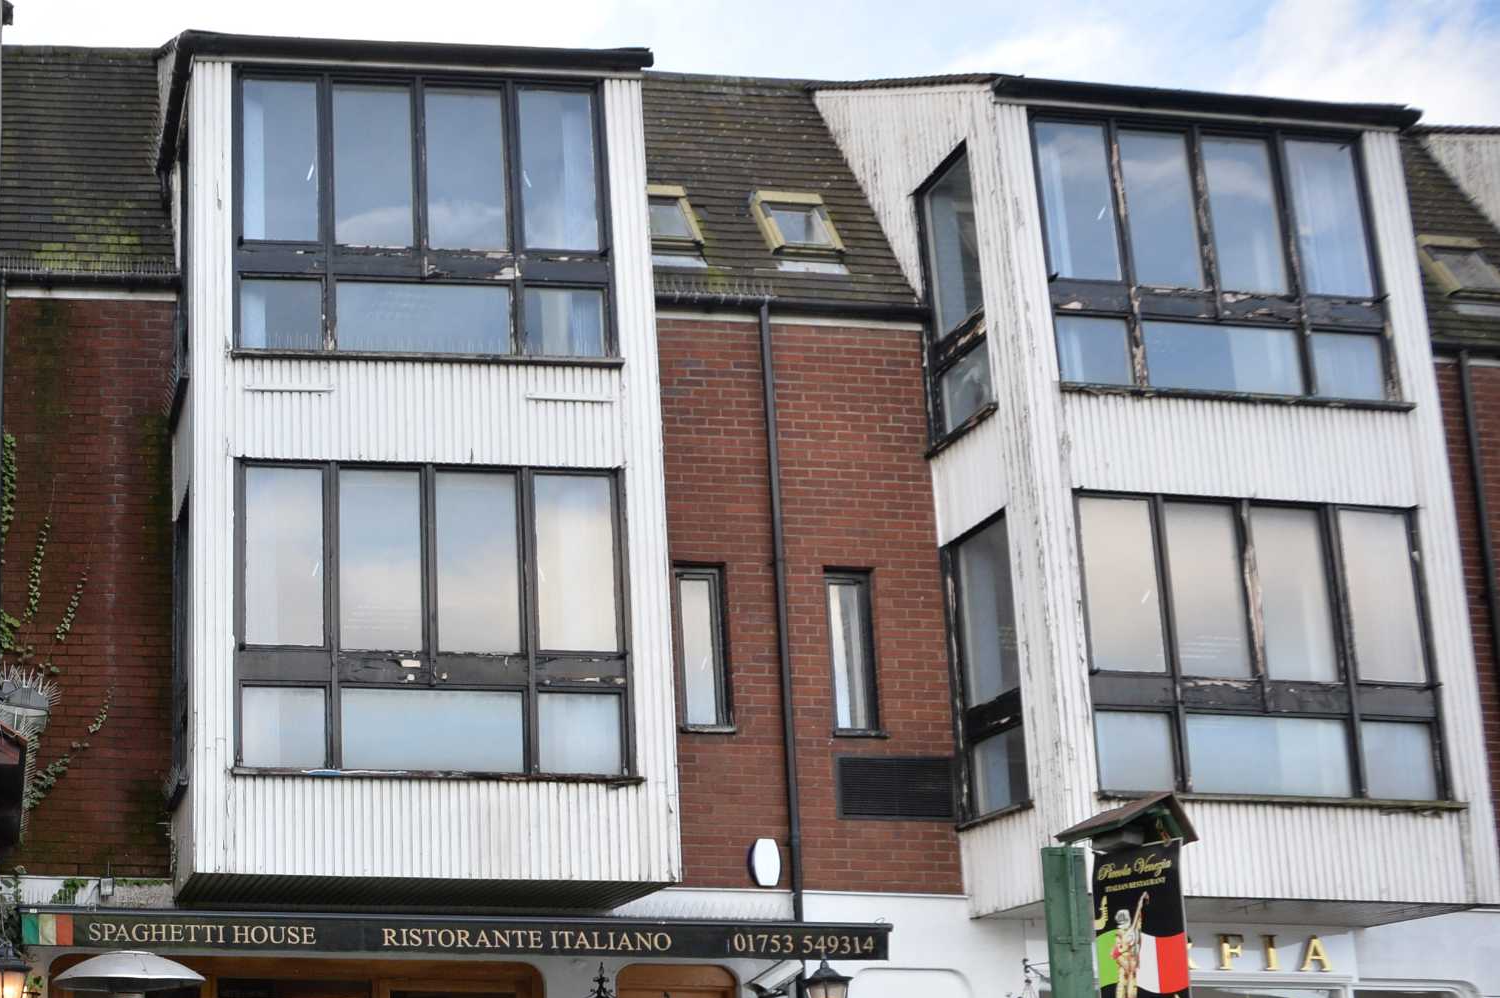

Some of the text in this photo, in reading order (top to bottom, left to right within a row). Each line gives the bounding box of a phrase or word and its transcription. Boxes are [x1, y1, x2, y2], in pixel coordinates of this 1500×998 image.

[1134, 853, 1172, 877] Venezia
[88, 922, 317, 945] SPAGHETTI HOUSE
[381, 927, 672, 952] RISTORANTE ITALIANO
[733, 932, 875, 954] 01753 549314
